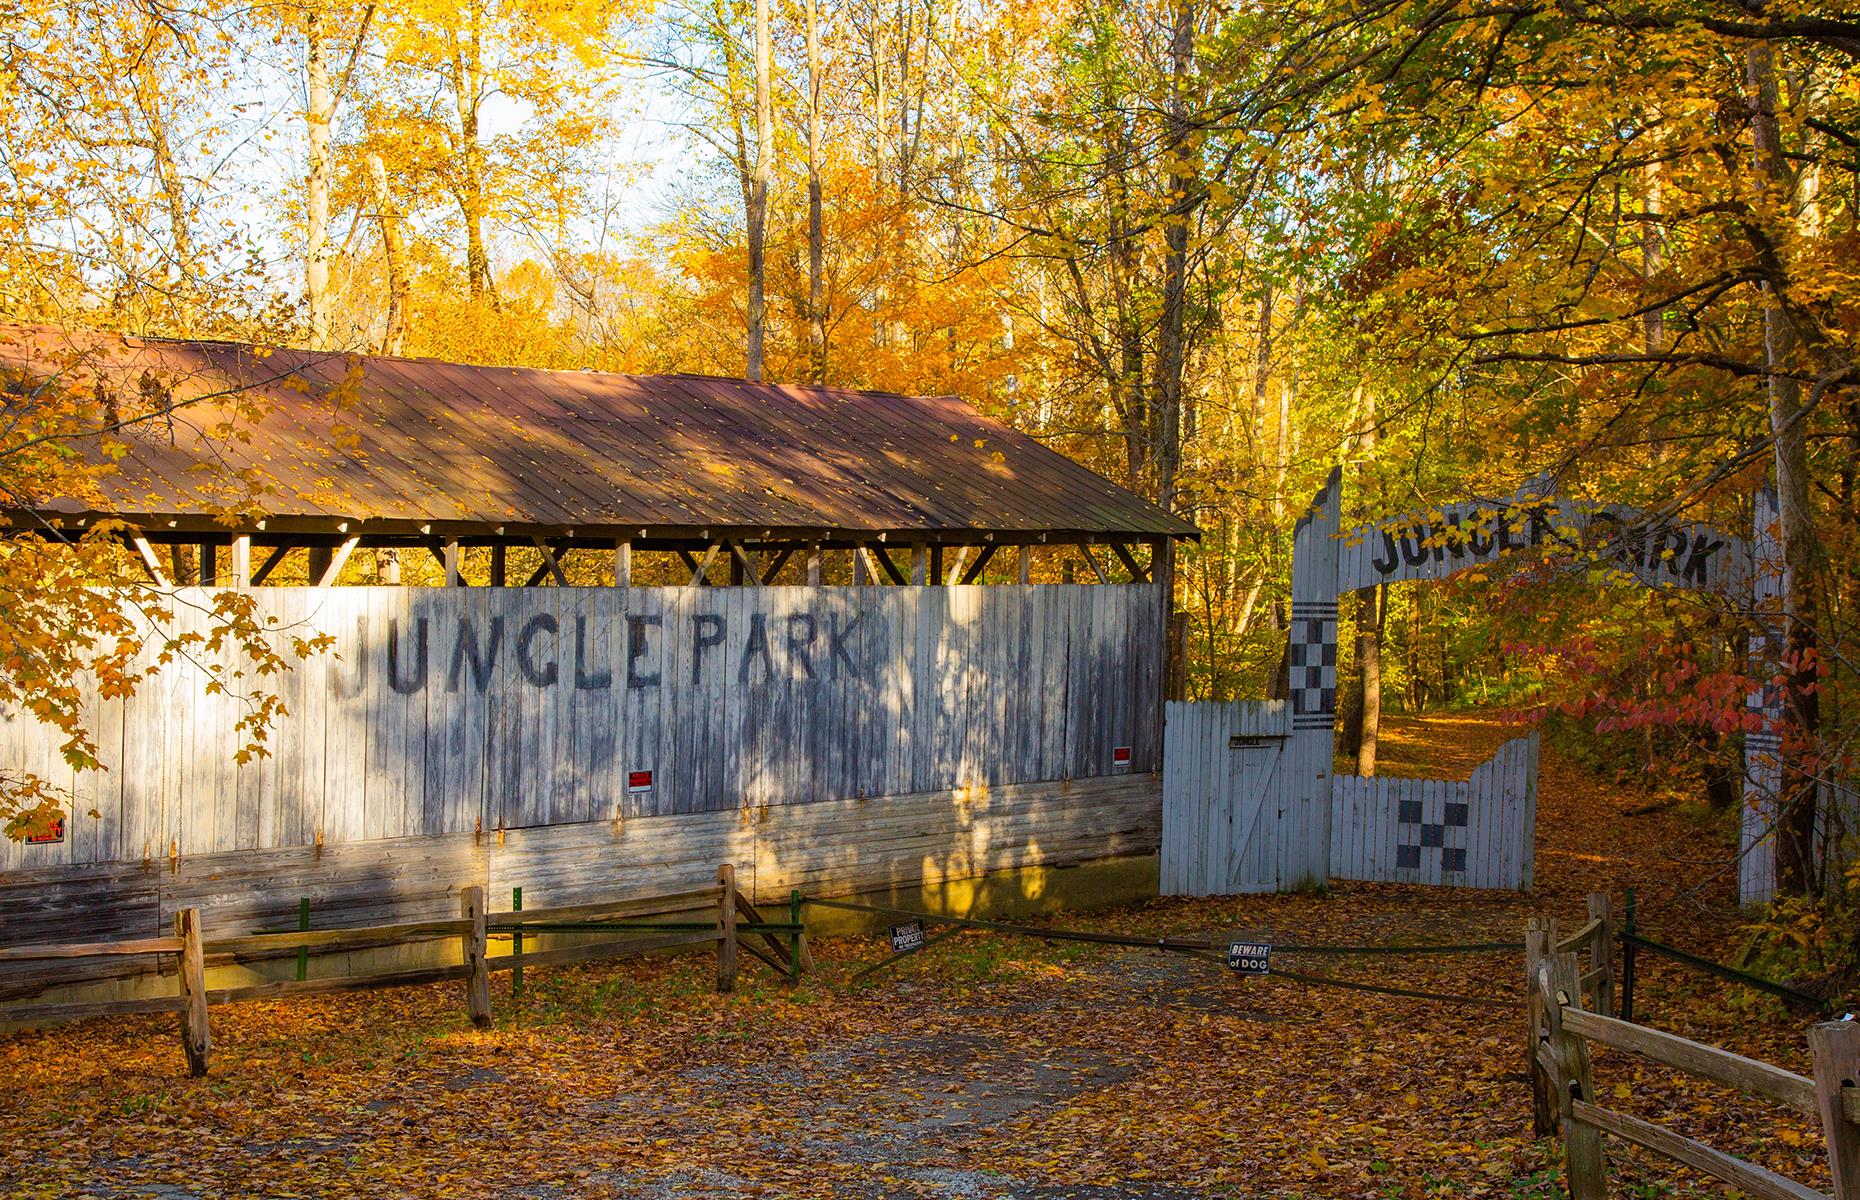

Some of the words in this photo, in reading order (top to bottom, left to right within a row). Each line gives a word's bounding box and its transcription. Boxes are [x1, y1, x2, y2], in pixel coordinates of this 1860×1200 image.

[329, 611, 662, 701] JUNGLE
[693, 609, 864, 685] PARK
[896, 922, 921, 936] PRIVATE
[893, 932, 925, 946] PROPERTY
[1232, 945, 1268, 956] BEWARE
[1230, 959, 1240, 968] of
[1241, 959, 1267, 970] DOG
